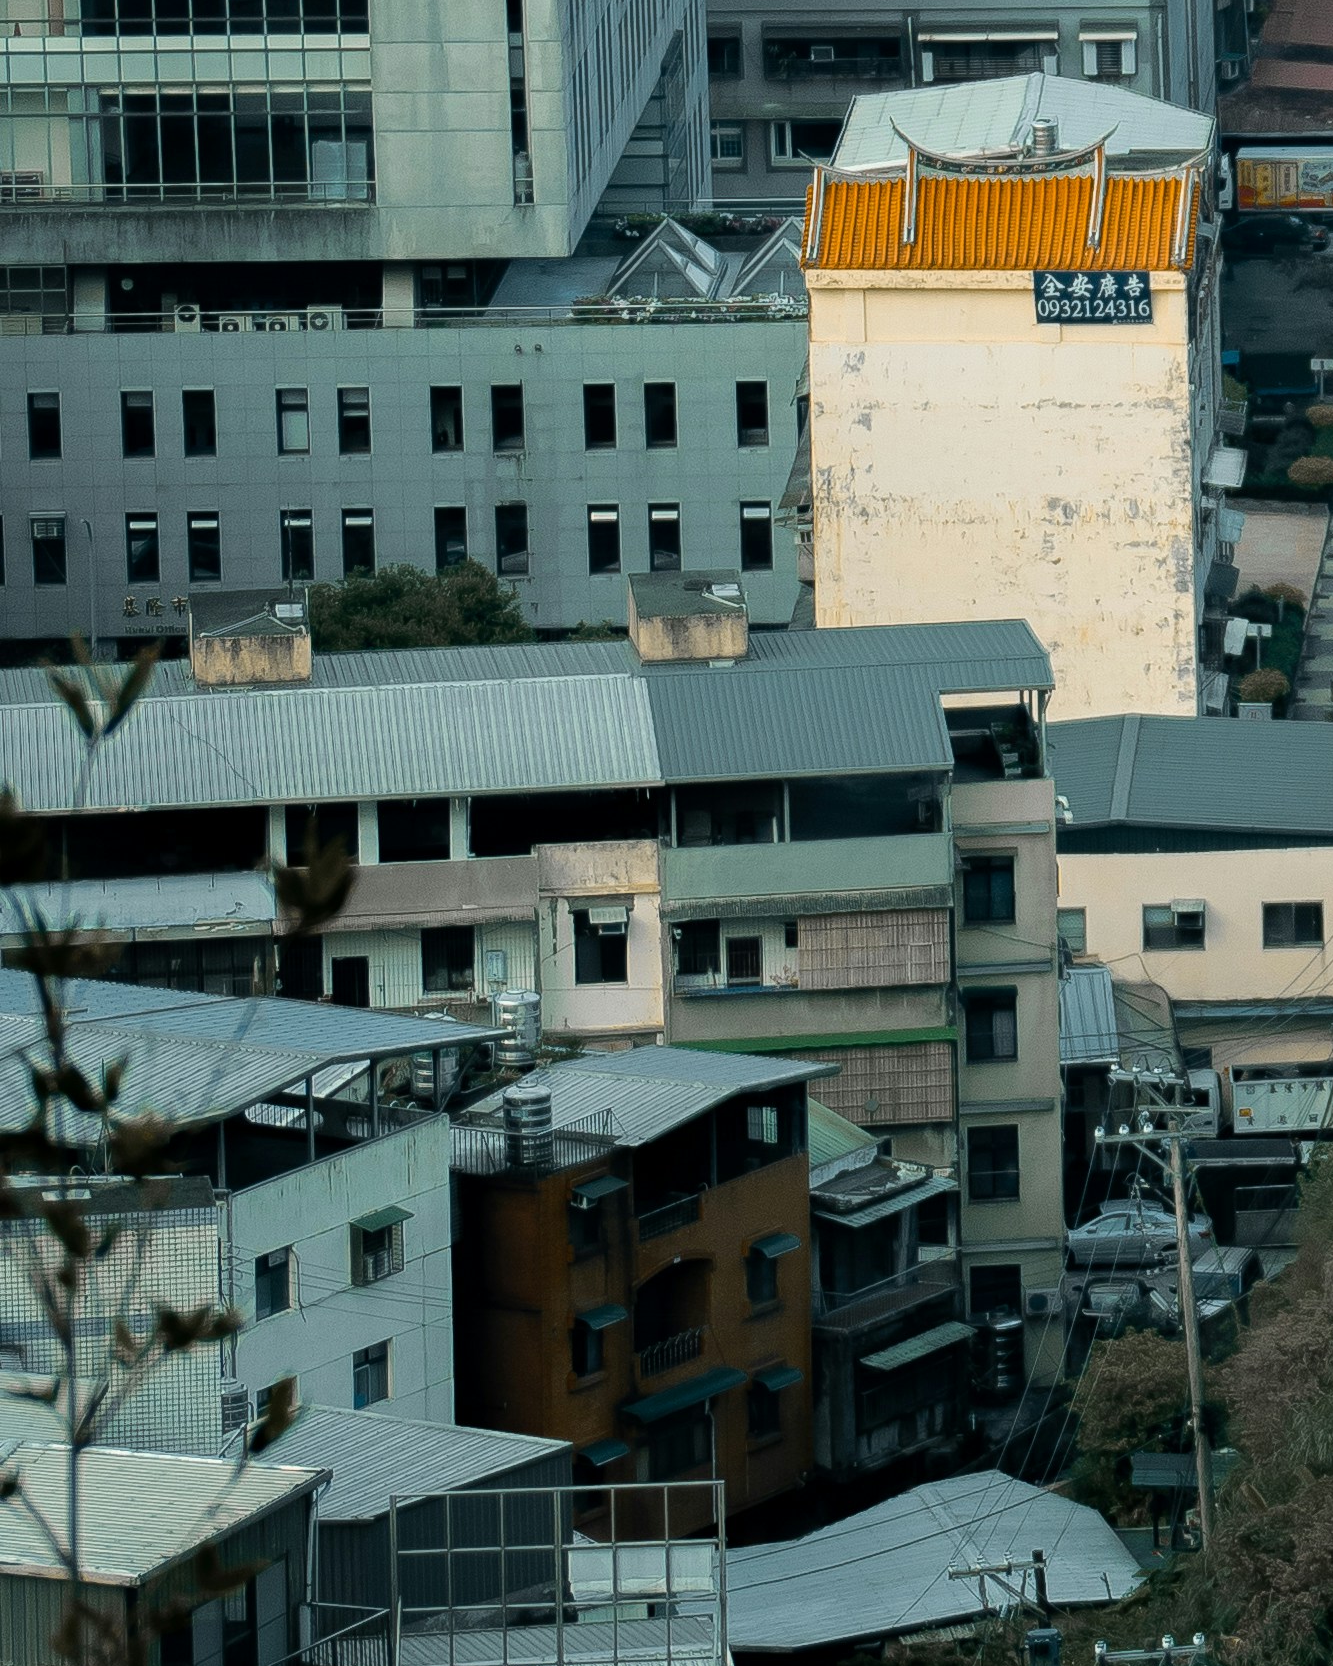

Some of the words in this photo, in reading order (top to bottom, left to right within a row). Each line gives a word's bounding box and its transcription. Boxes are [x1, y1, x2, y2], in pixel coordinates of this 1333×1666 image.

[1040, 272, 1145, 298] 全安廣告
[1037, 299, 1151, 318] 0932124316
